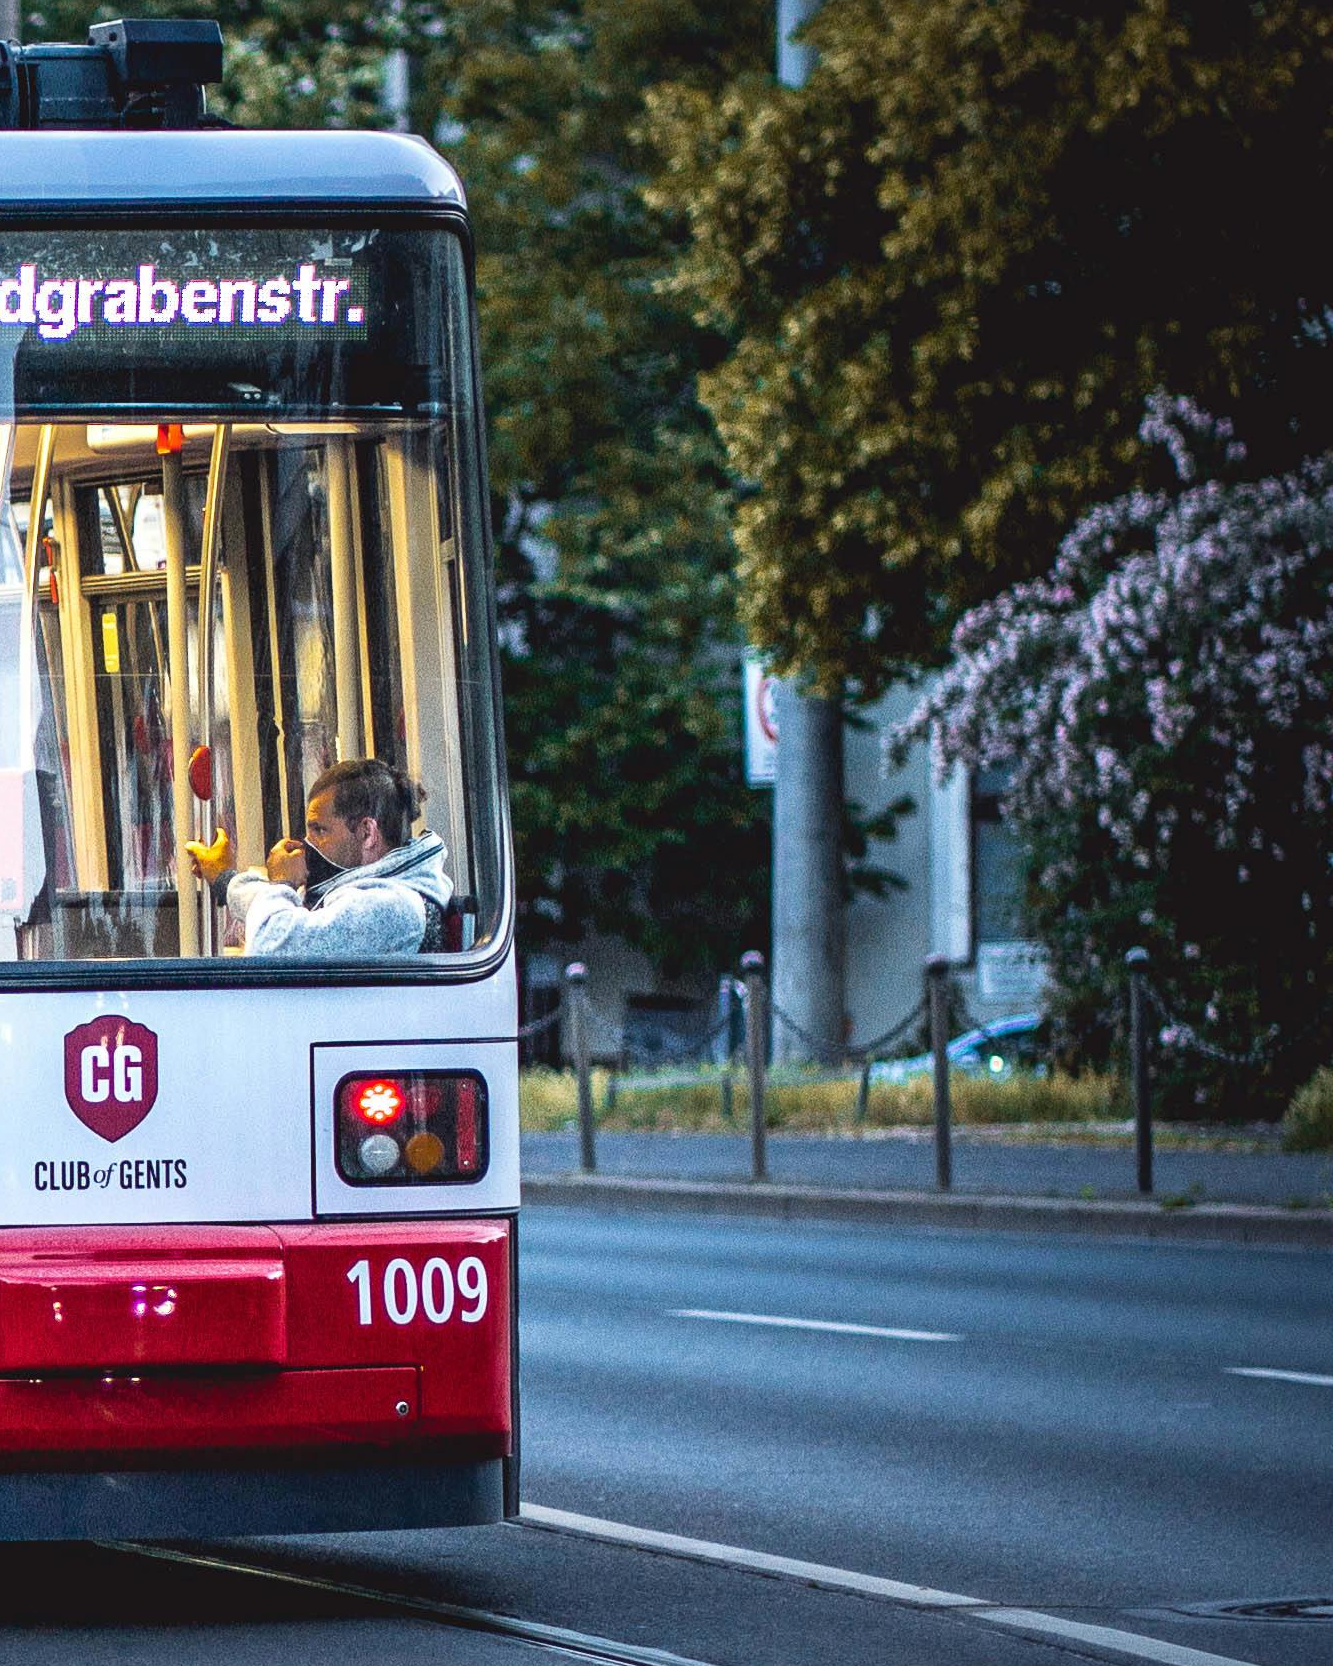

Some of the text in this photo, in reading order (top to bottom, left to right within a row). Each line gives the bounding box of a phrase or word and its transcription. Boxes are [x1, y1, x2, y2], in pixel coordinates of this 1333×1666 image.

[80, 1044, 144, 1104] CG
[34, 1158, 188, 1191] CLUB of GENTS
[346, 1256, 489, 1326] 1009
